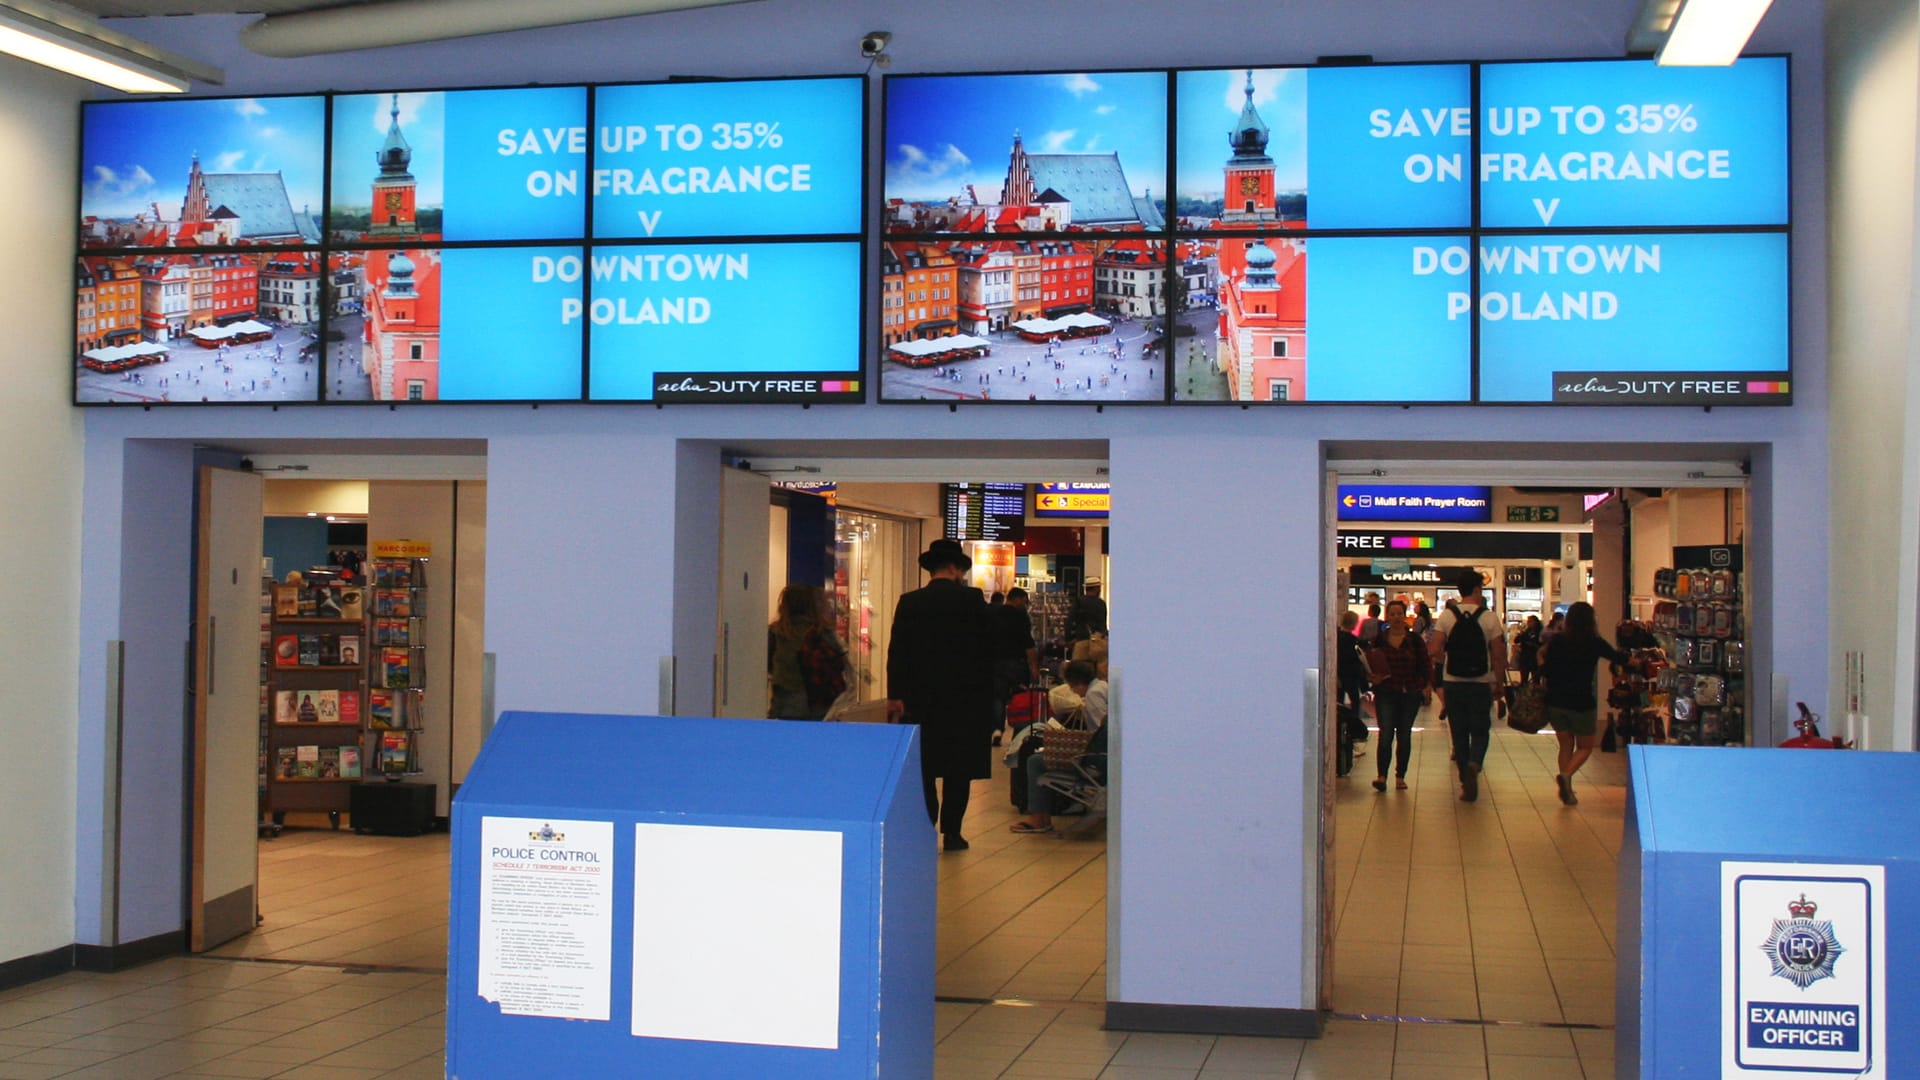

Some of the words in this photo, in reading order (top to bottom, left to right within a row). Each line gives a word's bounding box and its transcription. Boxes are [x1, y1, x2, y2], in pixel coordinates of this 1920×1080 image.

[1369, 108, 1471, 138] SAVE
[1489, 107, 1541, 136] UP
[1550, 106, 1605, 135] TO
[1615, 104, 1698, 134] 35%
[498, 127, 586, 155] SAVE
[602, 126, 647, 152] UP
[655, 124, 703, 151] TO
[711, 122, 783, 150] 35%
[1404, 153, 1461, 183] ON
[1481, 149, 1730, 182] FRAGRANCE
[526, 170, 577, 197] ON
[593, 164, 811, 195] FRAGRANCE
[638, 210, 662, 236] V
[1533, 198, 1560, 226] V
[532, 253, 749, 283] DOWNTOWN
[1412, 244, 1661, 276] DOWNTOWN
[561, 296, 711, 325] POLAND
[1447, 290, 1619, 321] POLAND
[709, 380, 761, 393] DUTY
[765, 380, 817, 393] FREE
[1618, 381, 1676, 394] DUTY
[1681, 381, 1741, 394] FREE
[1072, 497, 1108, 508] Special
[1374, 496, 1397, 507] Multi
[1398, 496, 1423, 507] Faith
[1424, 497, 1456, 509] Prayer
[1457, 497, 1486, 507] Room
[1382, 571, 1441, 581] CHANEL
[492, 847, 535, 860] POLICE
[540, 849, 600, 863] CONTROL
[569, 864, 583, 872] ACT
[584, 865, 600, 873] 2000
[1751, 1008, 1856, 1027] EXAMINING
[1763, 1028, 1844, 1046] OFFICER
